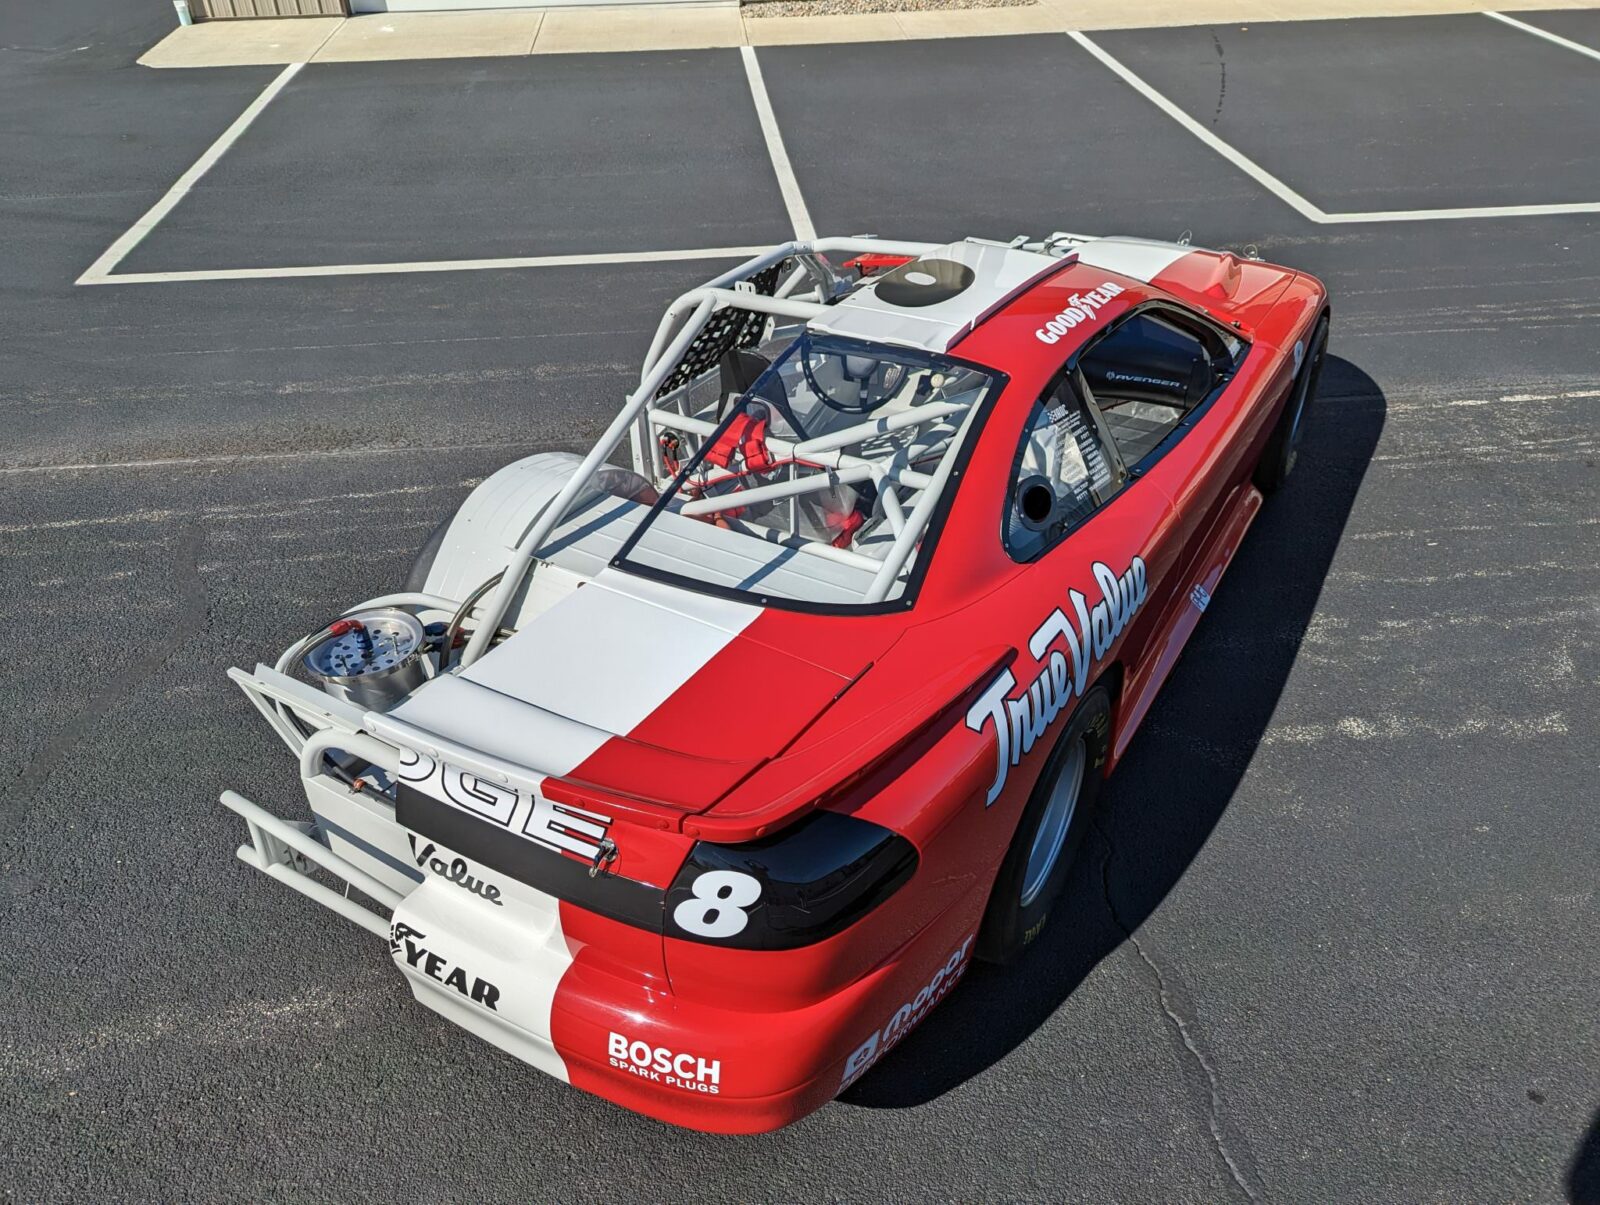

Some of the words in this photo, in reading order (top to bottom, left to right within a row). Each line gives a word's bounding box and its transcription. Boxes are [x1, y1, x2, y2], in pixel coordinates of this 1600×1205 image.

[1035, 282, 1125, 344] GOODYEAR
[1115, 374, 1180, 387] AVENGER
[408, 833, 503, 906] Value
[673, 870, 762, 937] 8
[608, 1031, 720, 1084] BOSCH
[609, 1057, 660, 1082] SPARK
[665, 1075, 719, 1095] PLUGS
